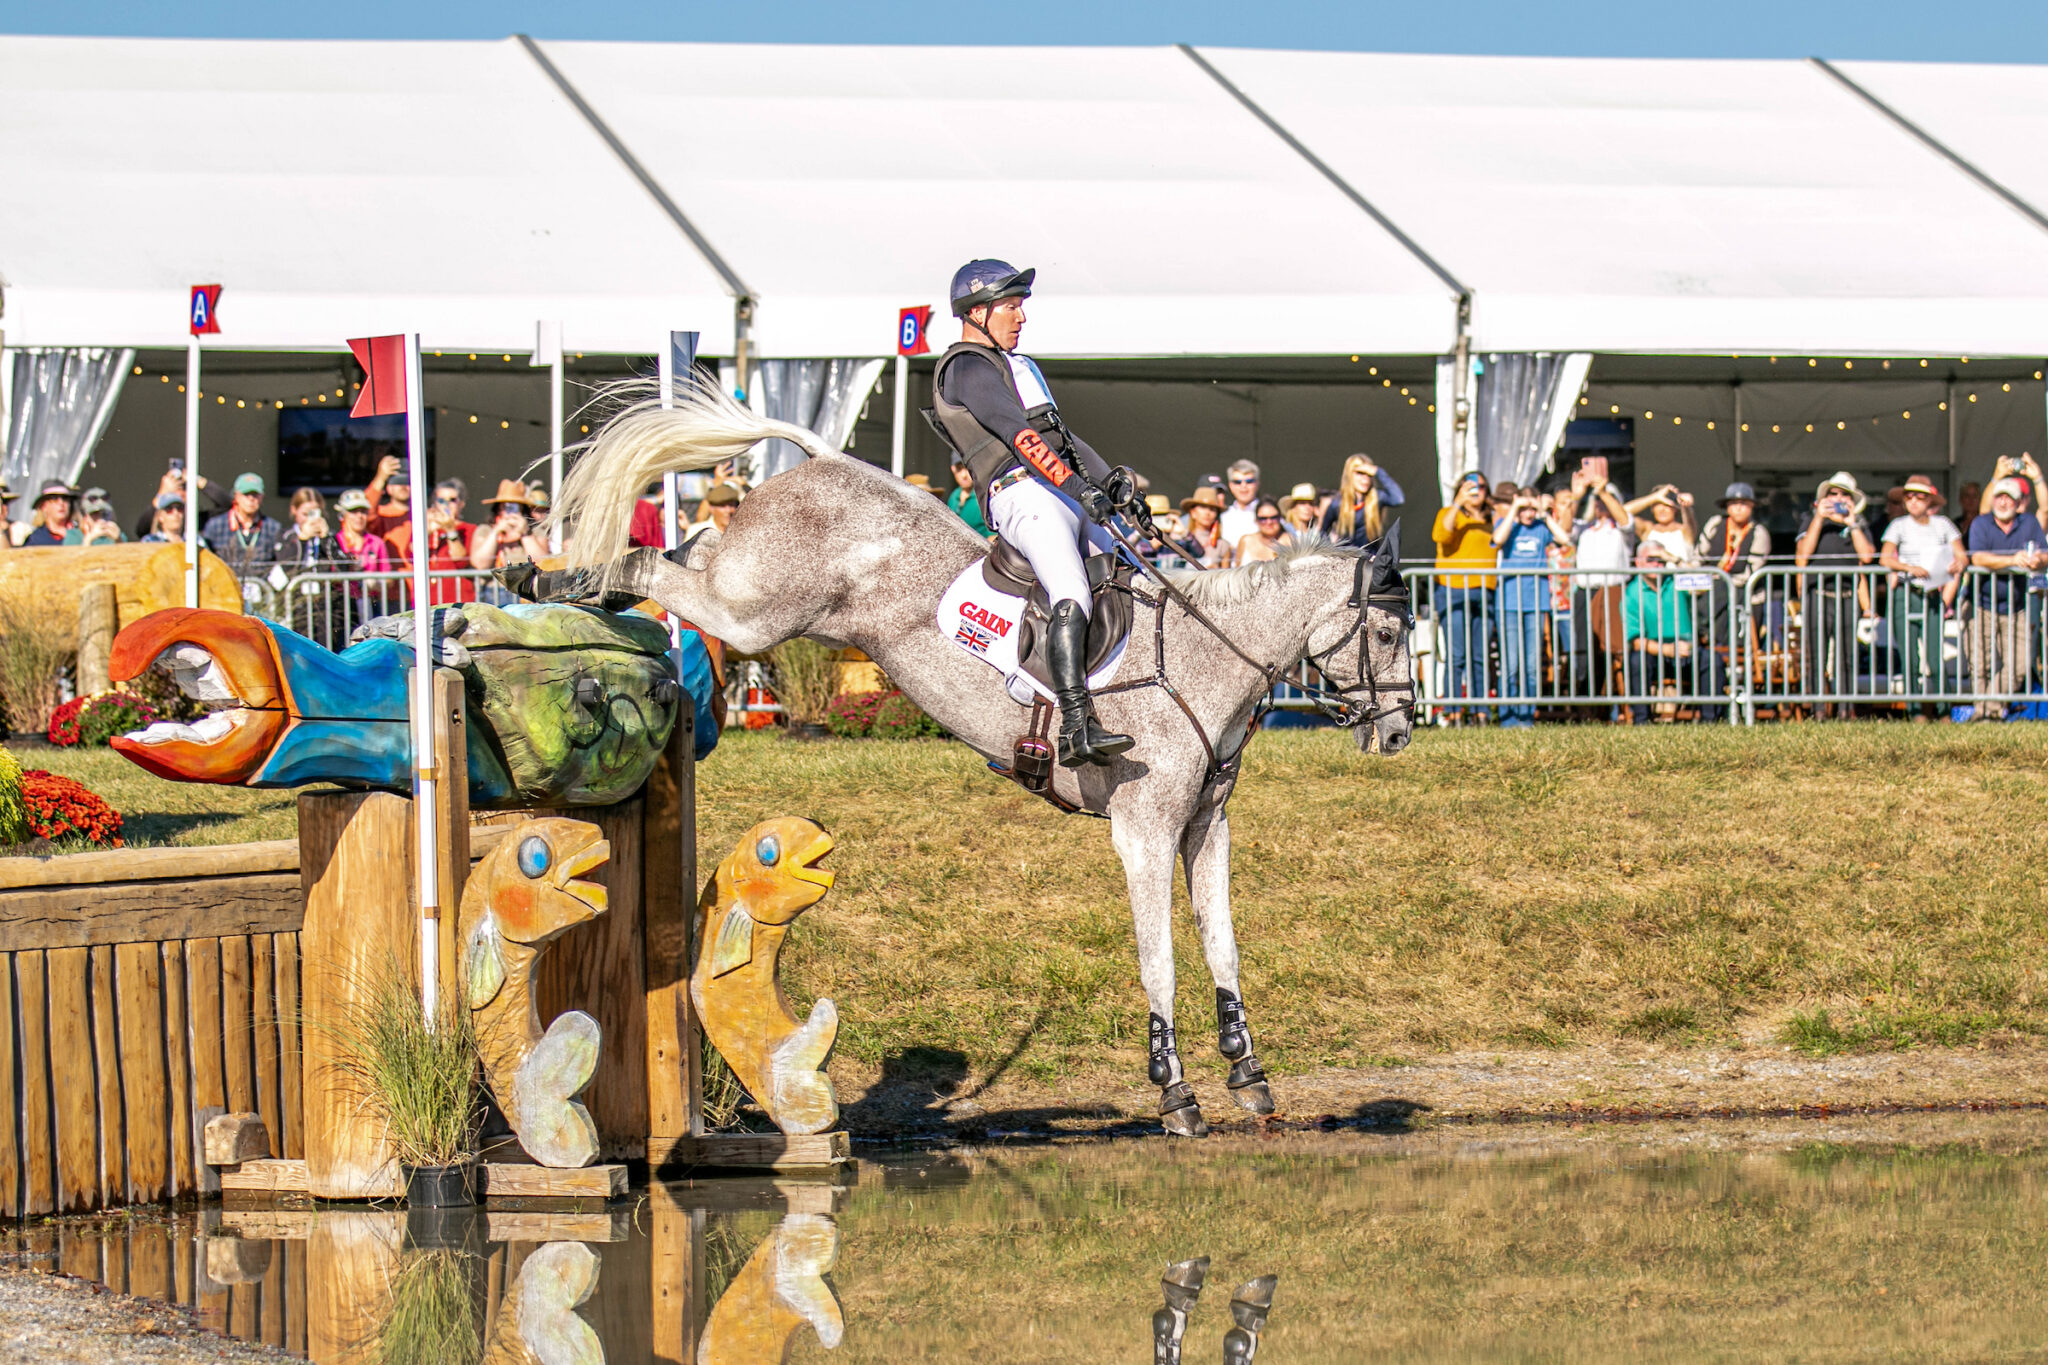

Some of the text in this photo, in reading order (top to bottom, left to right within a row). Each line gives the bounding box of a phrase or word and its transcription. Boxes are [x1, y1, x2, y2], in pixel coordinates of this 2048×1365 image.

[193, 293, 207, 323] A
[903, 318, 916, 345] B
[1014, 428, 1074, 487] GAIN
[959, 601, 1013, 638] GAIN
